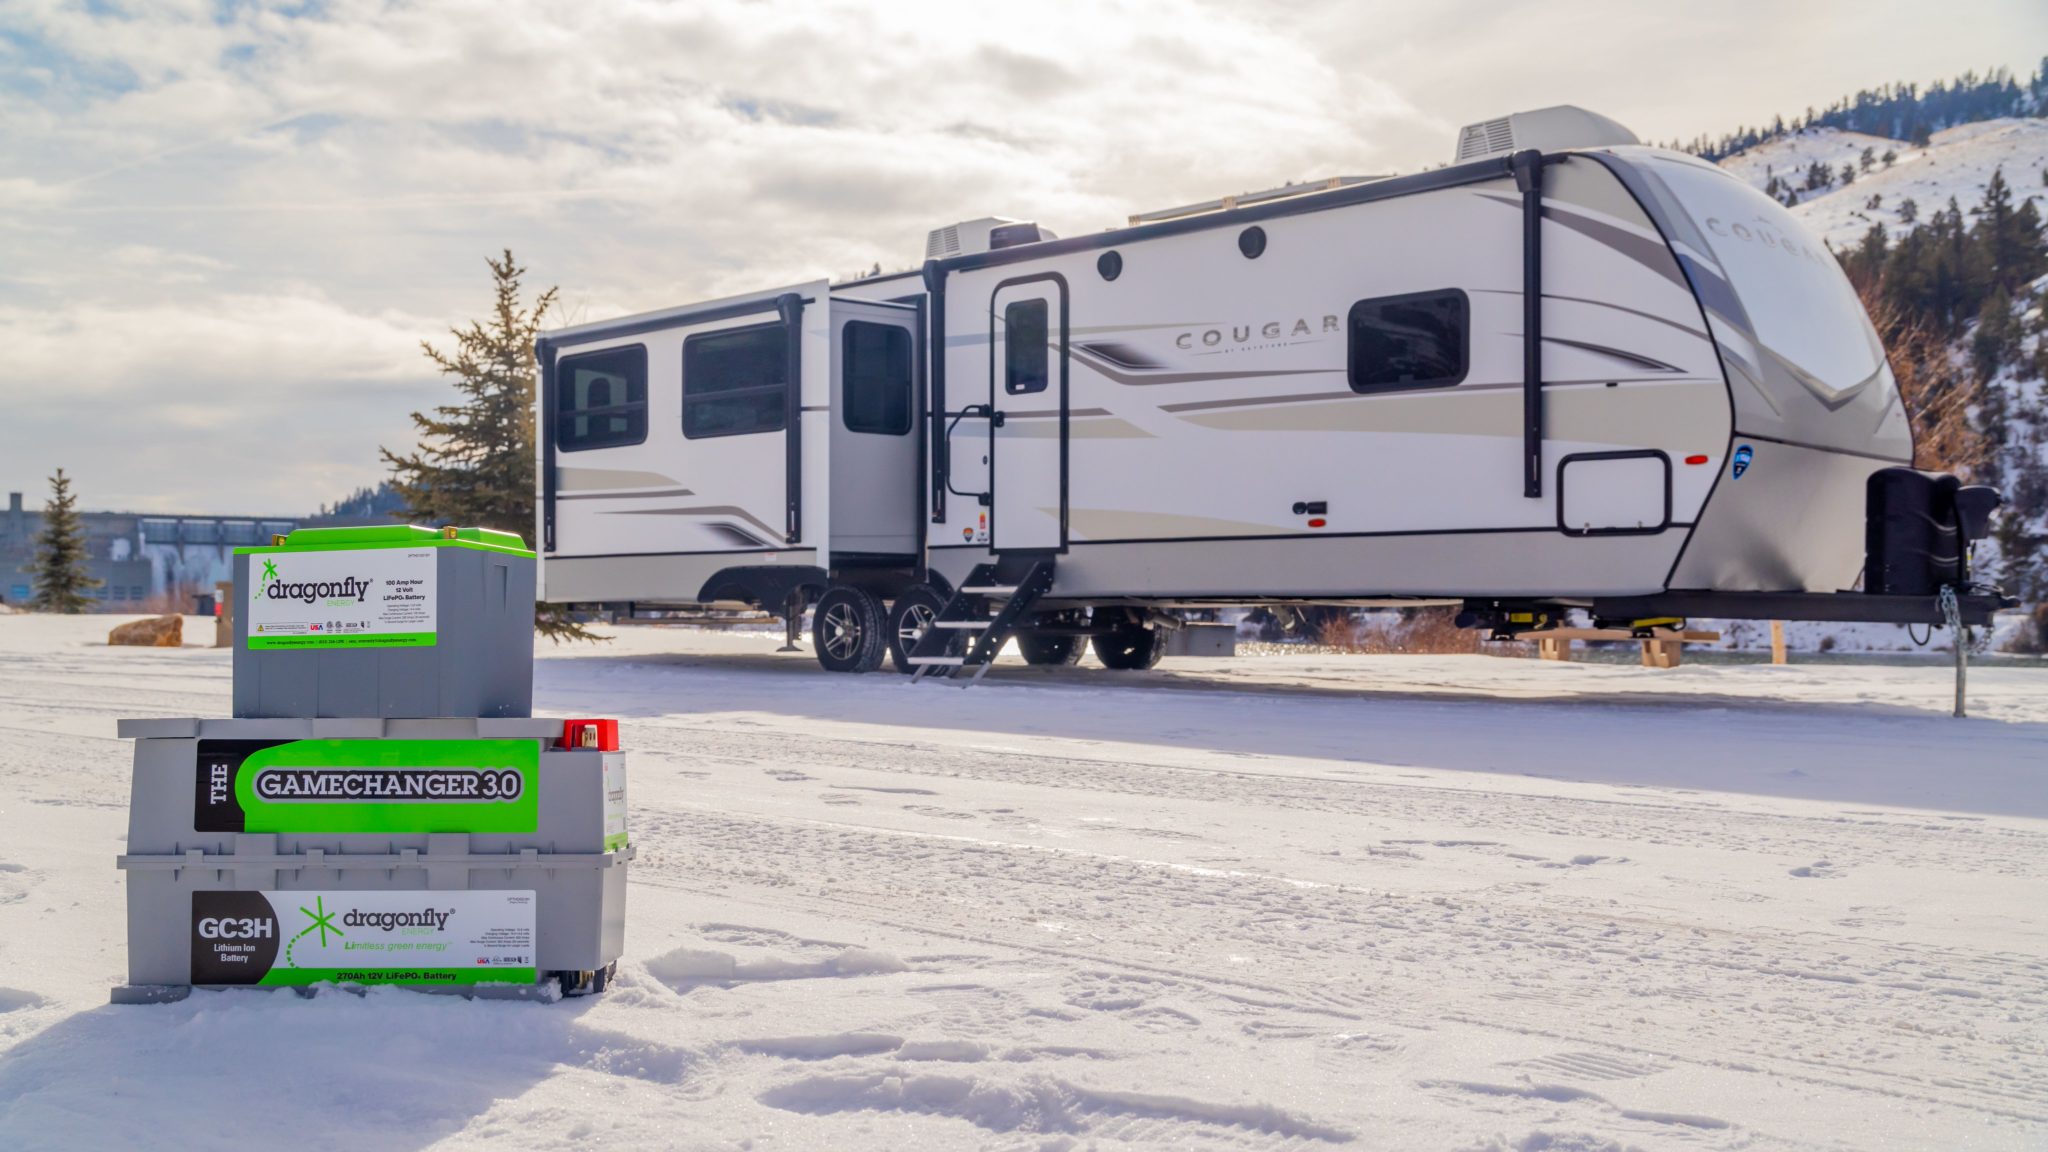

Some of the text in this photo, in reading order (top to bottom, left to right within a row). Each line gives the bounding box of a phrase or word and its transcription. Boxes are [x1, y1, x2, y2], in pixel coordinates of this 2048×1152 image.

[1705, 216, 1832, 269] COUG
[1175, 315, 1340, 350] COUGAR
[267, 576, 369, 604] dragonfly
[210, 764, 228, 804] THE
[260, 773, 518, 797] GAMECHANGER 3.0
[198, 917, 272, 939] GC3H
[343, 908, 450, 931] dragonfly
[401, 928, 435, 936] ENERGY
[213, 943, 256, 952] Lithium Ion
[344, 941, 448, 952] Limitless green energy
[220, 953, 249, 963] Battery
[336, 972, 365, 980] 270Ah
[368, 972, 383, 980] 12V
[423, 972, 457, 981] Battery
